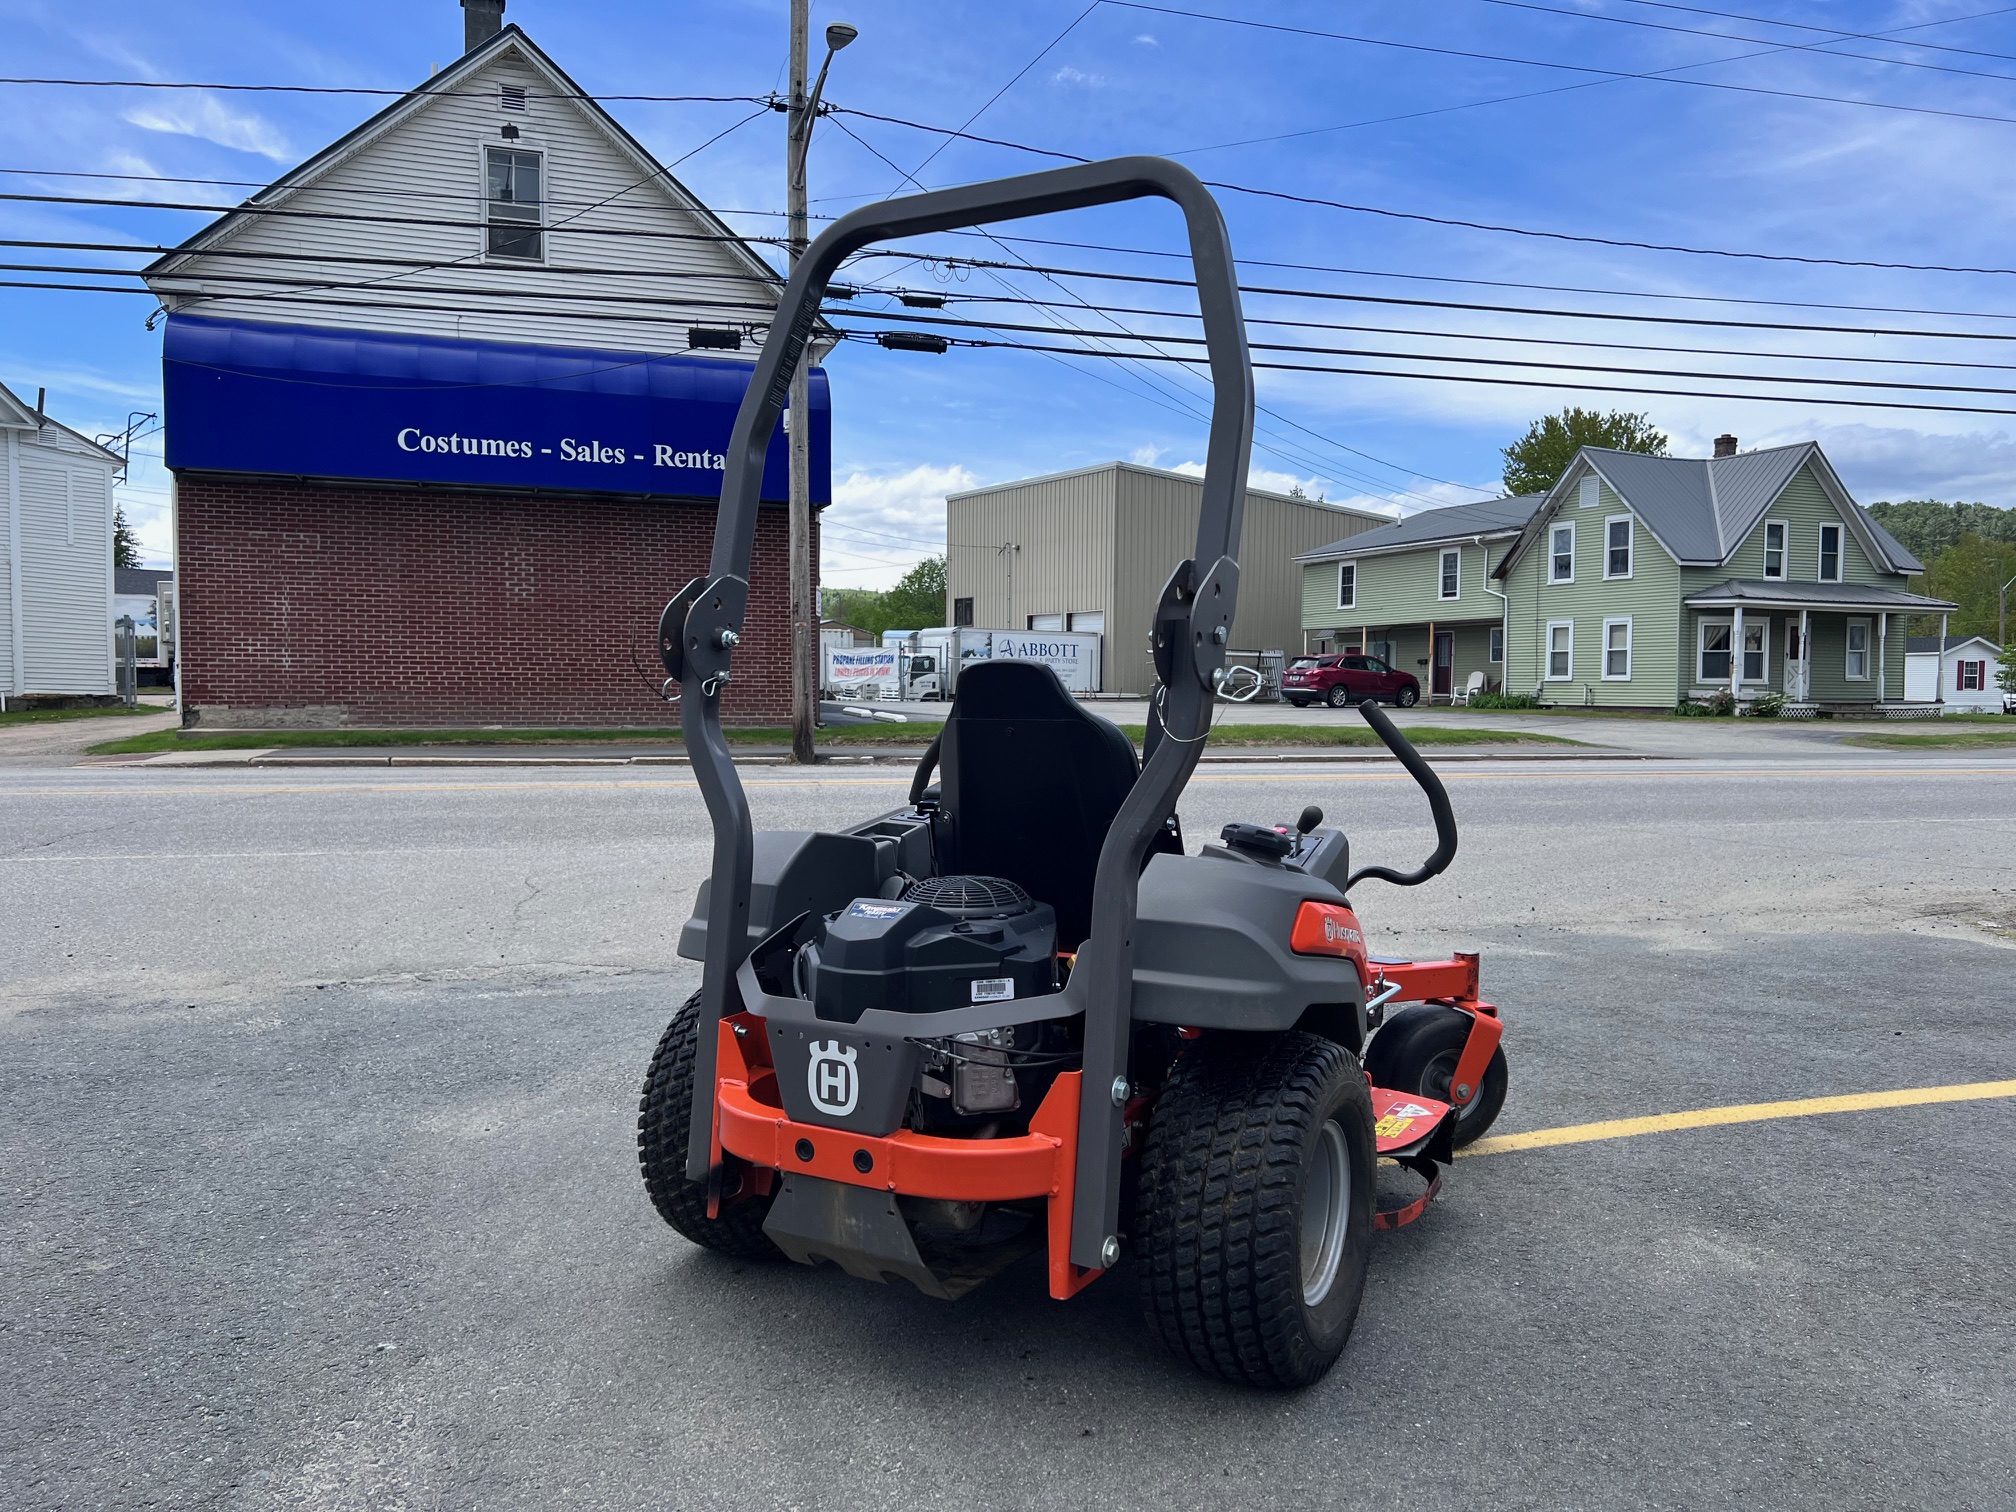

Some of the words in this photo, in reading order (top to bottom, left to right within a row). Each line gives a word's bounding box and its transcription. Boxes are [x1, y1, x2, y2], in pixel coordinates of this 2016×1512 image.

[397, 428, 533, 458] Costumes
[560, 438, 626, 464] Sales
[653, 444, 729, 470] Renta
[1018, 642, 1079, 658] ABBOTT
